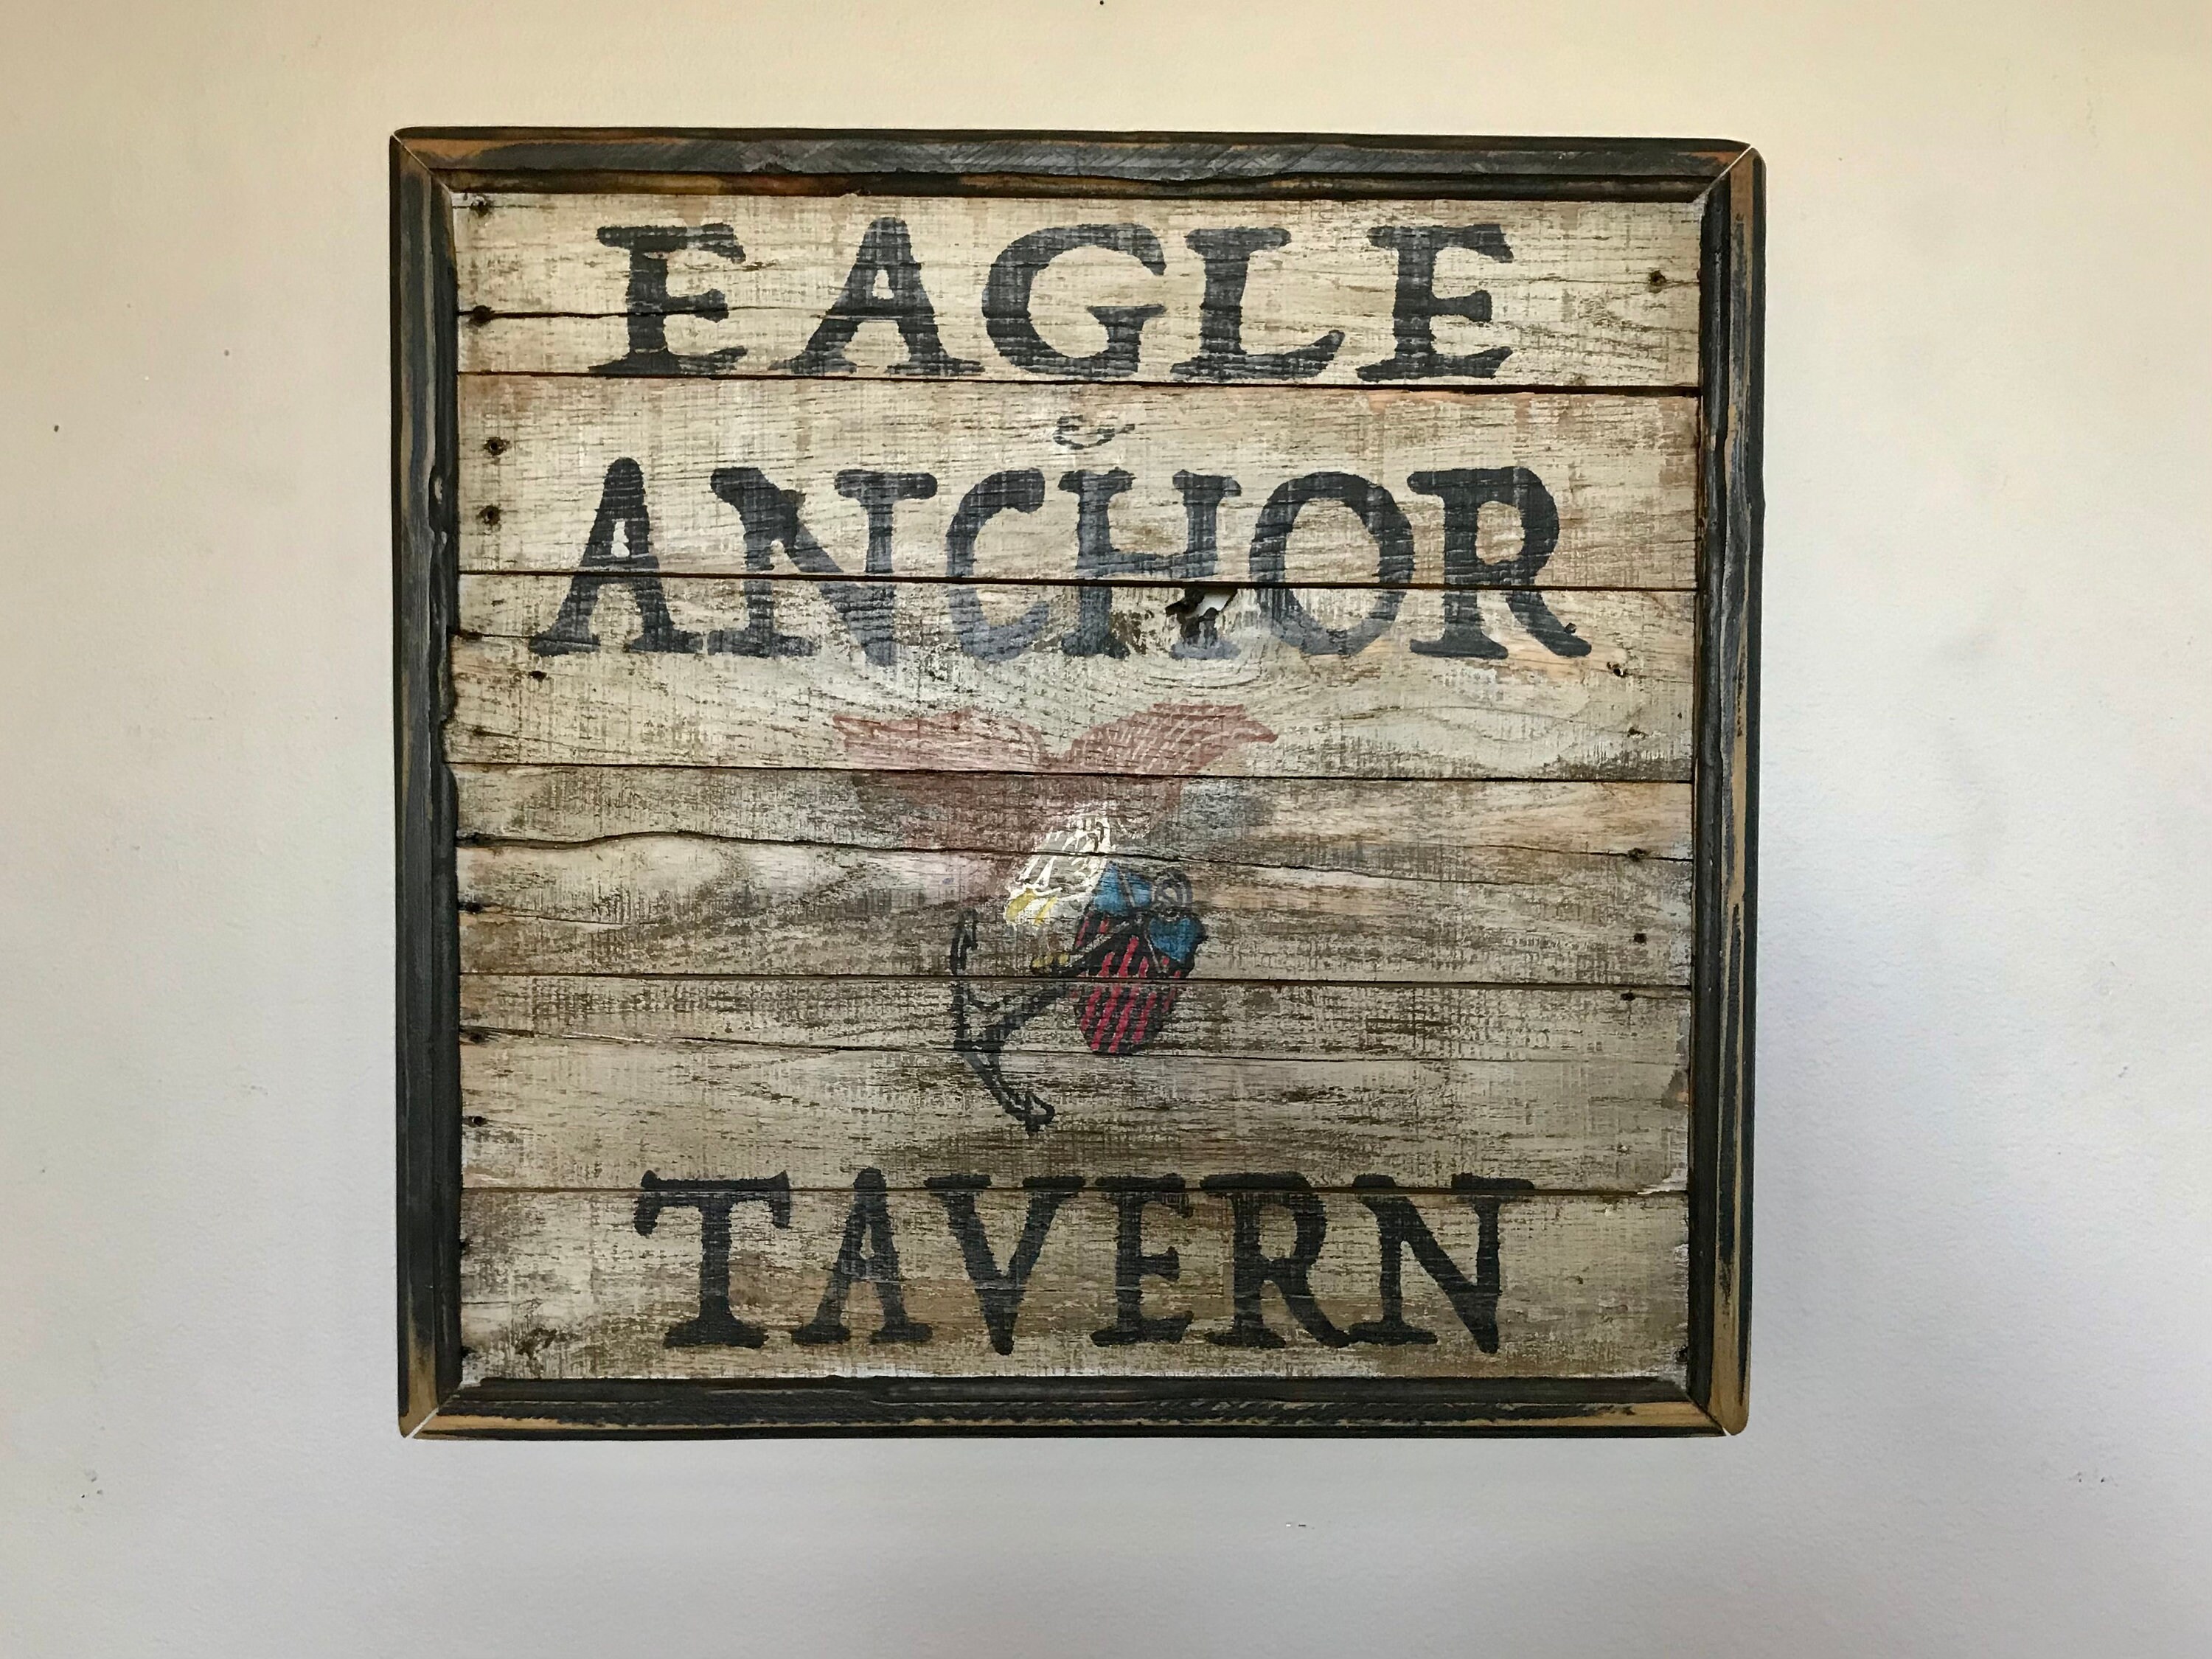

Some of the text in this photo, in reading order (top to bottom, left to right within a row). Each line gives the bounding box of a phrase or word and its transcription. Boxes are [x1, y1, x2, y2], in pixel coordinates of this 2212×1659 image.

[589, 216, 1514, 381] EAGLE
[532, 456, 1593, 663] ANCHOR
[633, 1167, 1535, 1355] TAVERN
